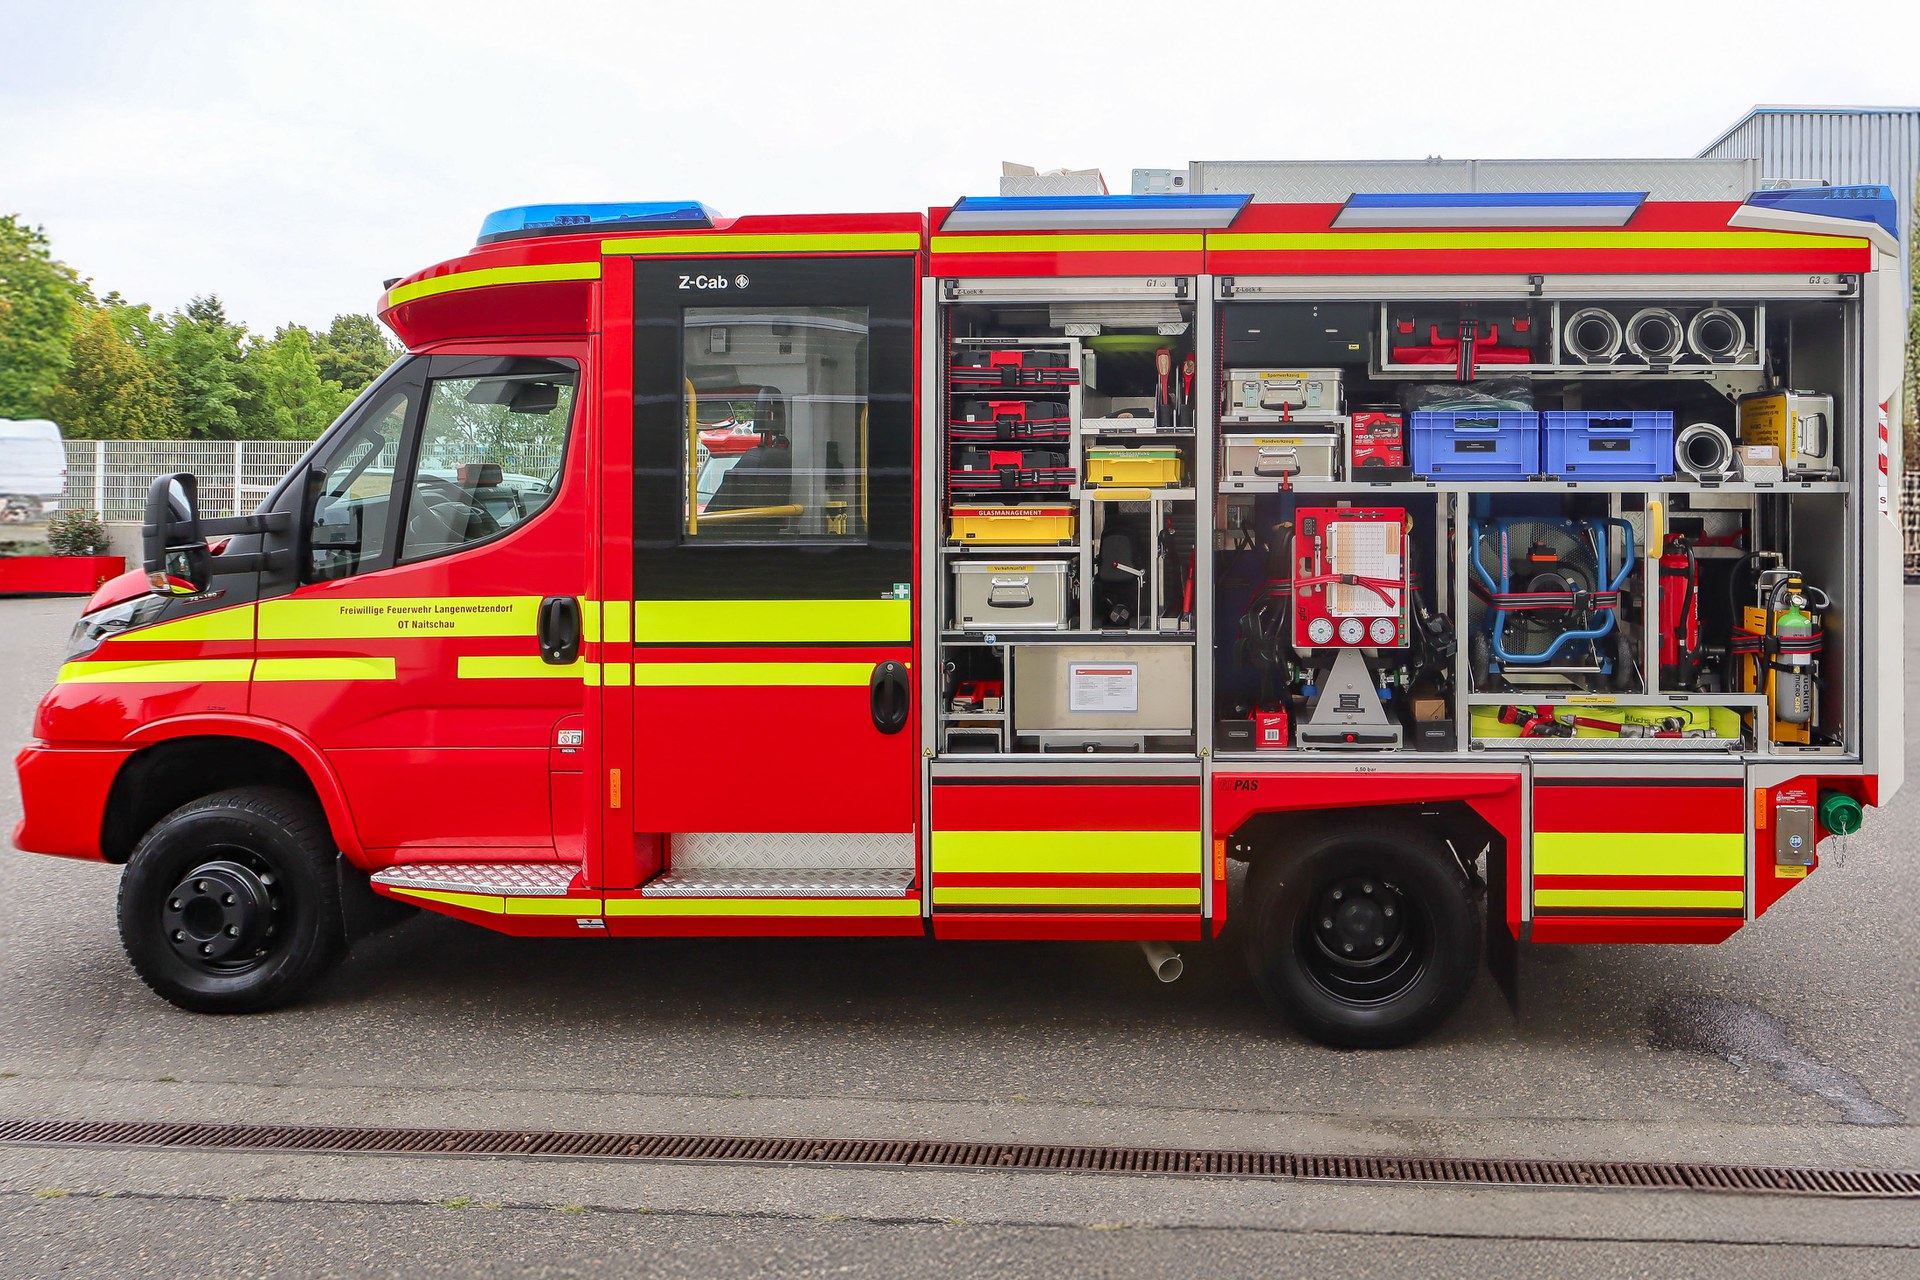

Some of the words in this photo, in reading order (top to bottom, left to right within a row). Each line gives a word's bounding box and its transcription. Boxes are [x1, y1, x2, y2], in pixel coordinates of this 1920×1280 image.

[678, 274, 728, 290] Z-Cab
[1146, 278, 1157, 288] G1
[1808, 275, 1821, 285] G3
[340, 605, 384, 615] Freiwillige
[387, 604, 432, 614] Feuerwehr
[434, 603, 513, 615] Langenwetzendorf
[398, 620, 409, 629] OT
[411, 619, 455, 629] Naitschau
